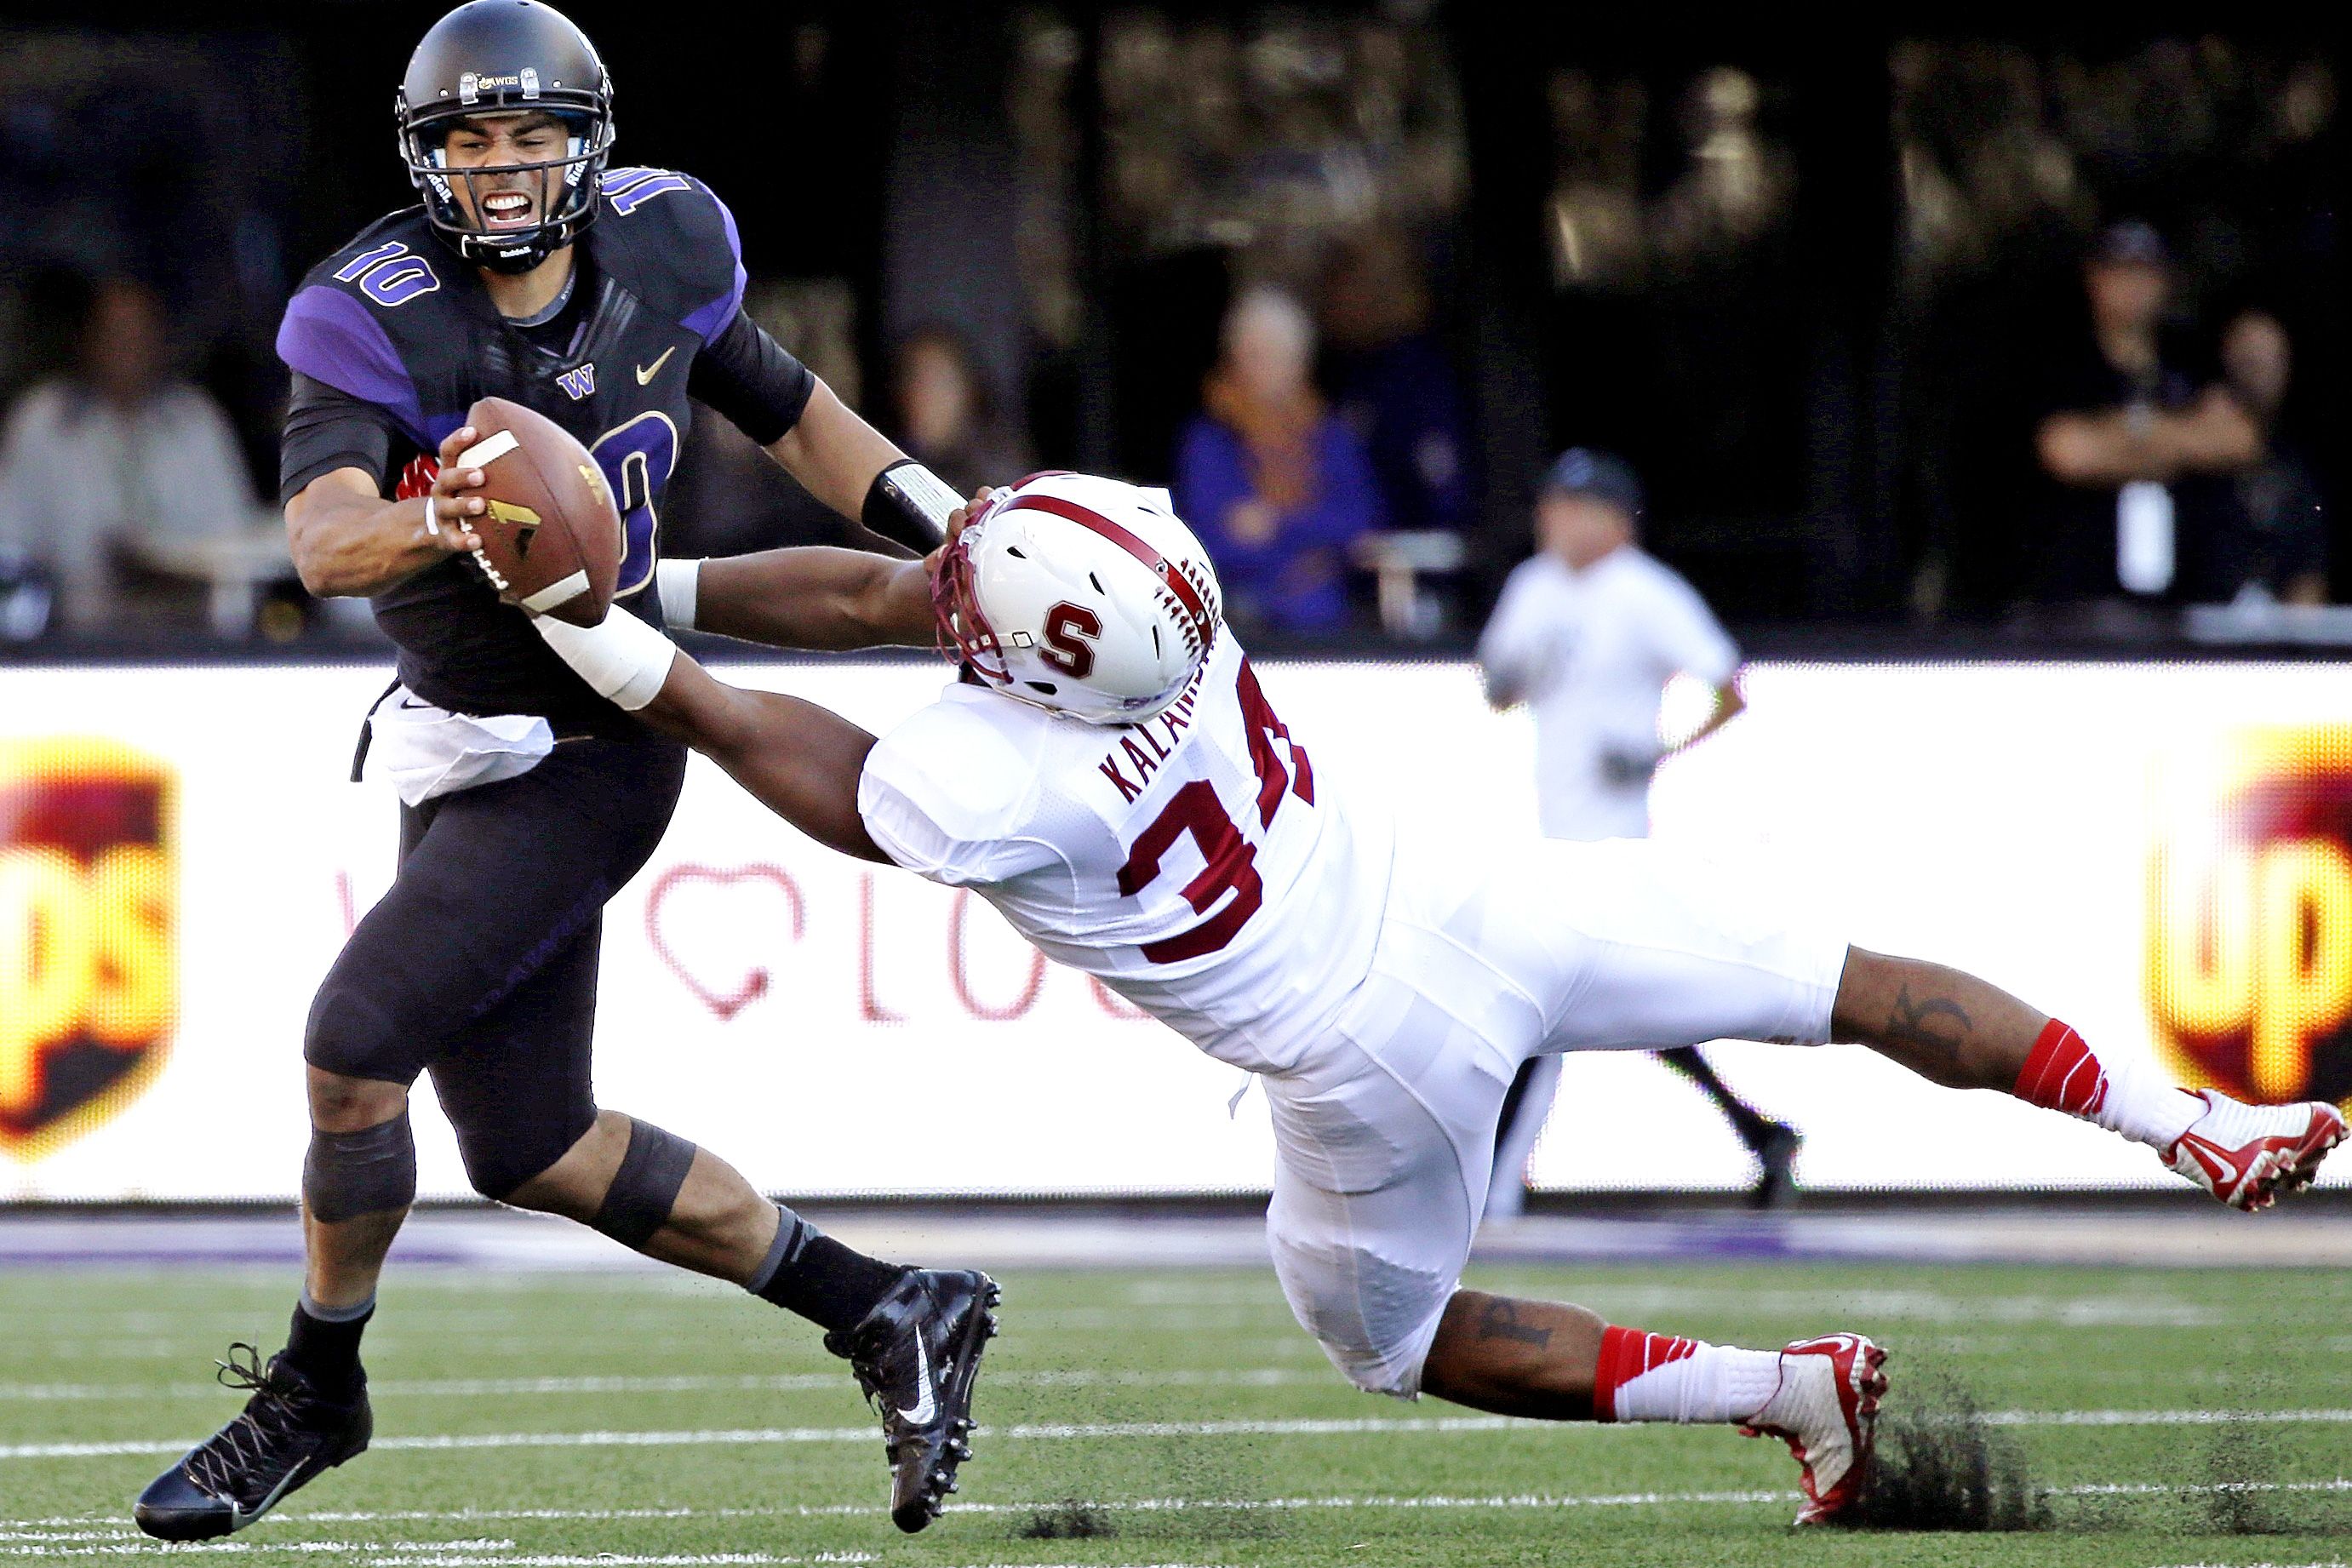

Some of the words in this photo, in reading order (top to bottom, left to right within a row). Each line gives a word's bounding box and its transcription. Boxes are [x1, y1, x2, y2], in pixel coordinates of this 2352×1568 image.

[333, 240, 441, 307] 10
[557, 363, 597, 401] W
[1037, 600, 1104, 680] S
[1117, 654, 1314, 964] 34
